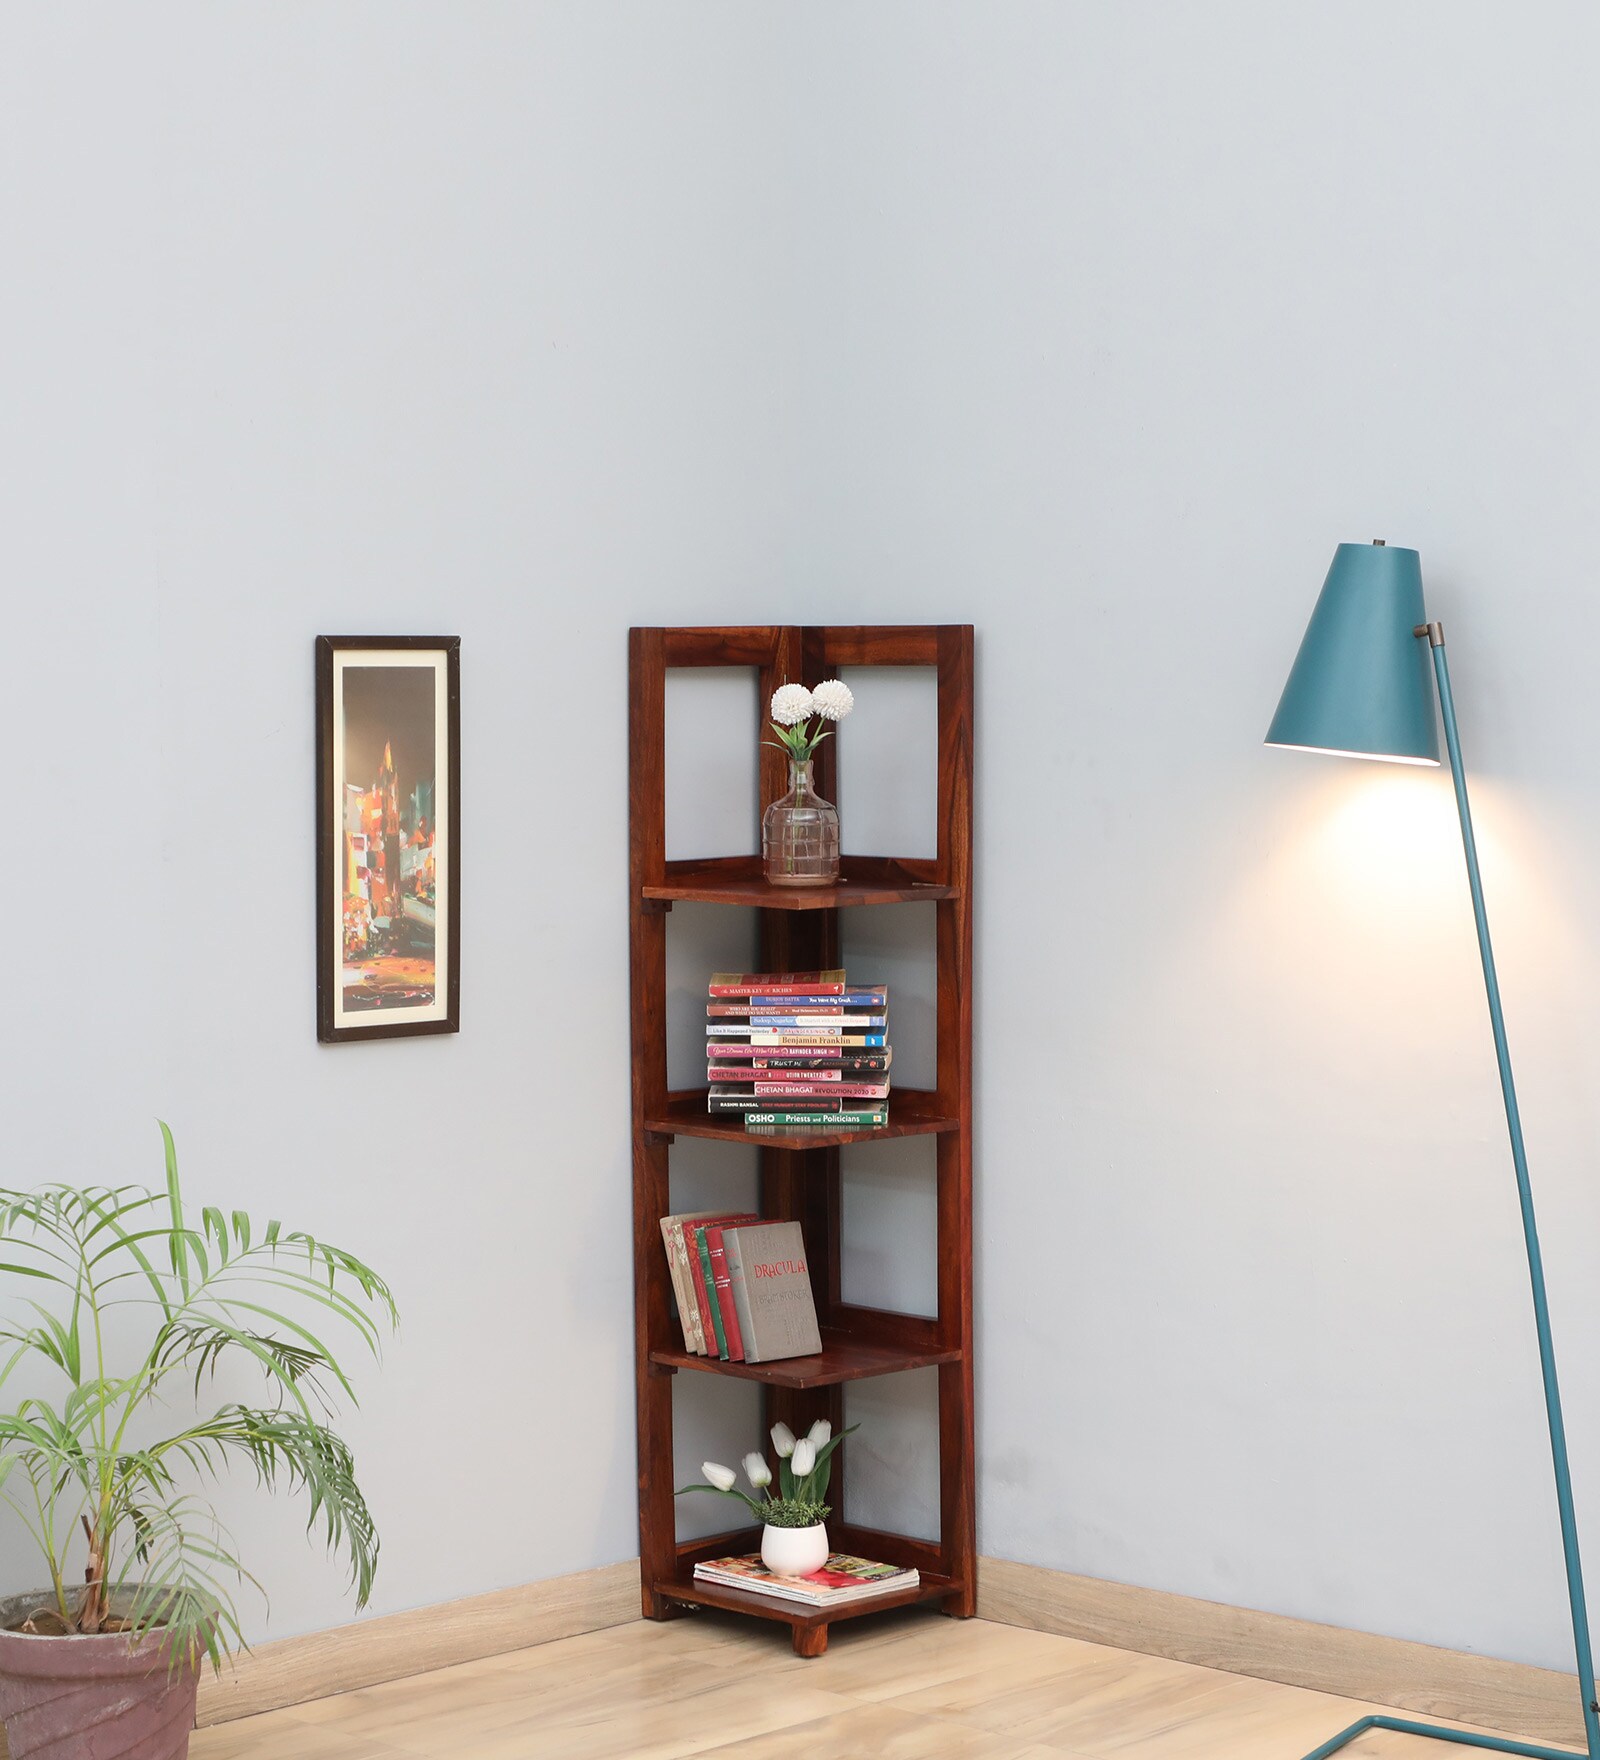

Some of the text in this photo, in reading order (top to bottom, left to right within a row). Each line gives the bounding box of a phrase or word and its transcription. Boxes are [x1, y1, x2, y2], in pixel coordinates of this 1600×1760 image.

[782, 1036, 851, 1045] Benjamin Franklin
[755, 1086, 813, 1094] CHETAN BHAGAT
[748, 1114, 775, 1123] OSHO
[785, 1114, 811, 1123] Priests
[823, 1114, 860, 1123] Politicians
[754, 1259, 807, 1279] DRACULA
